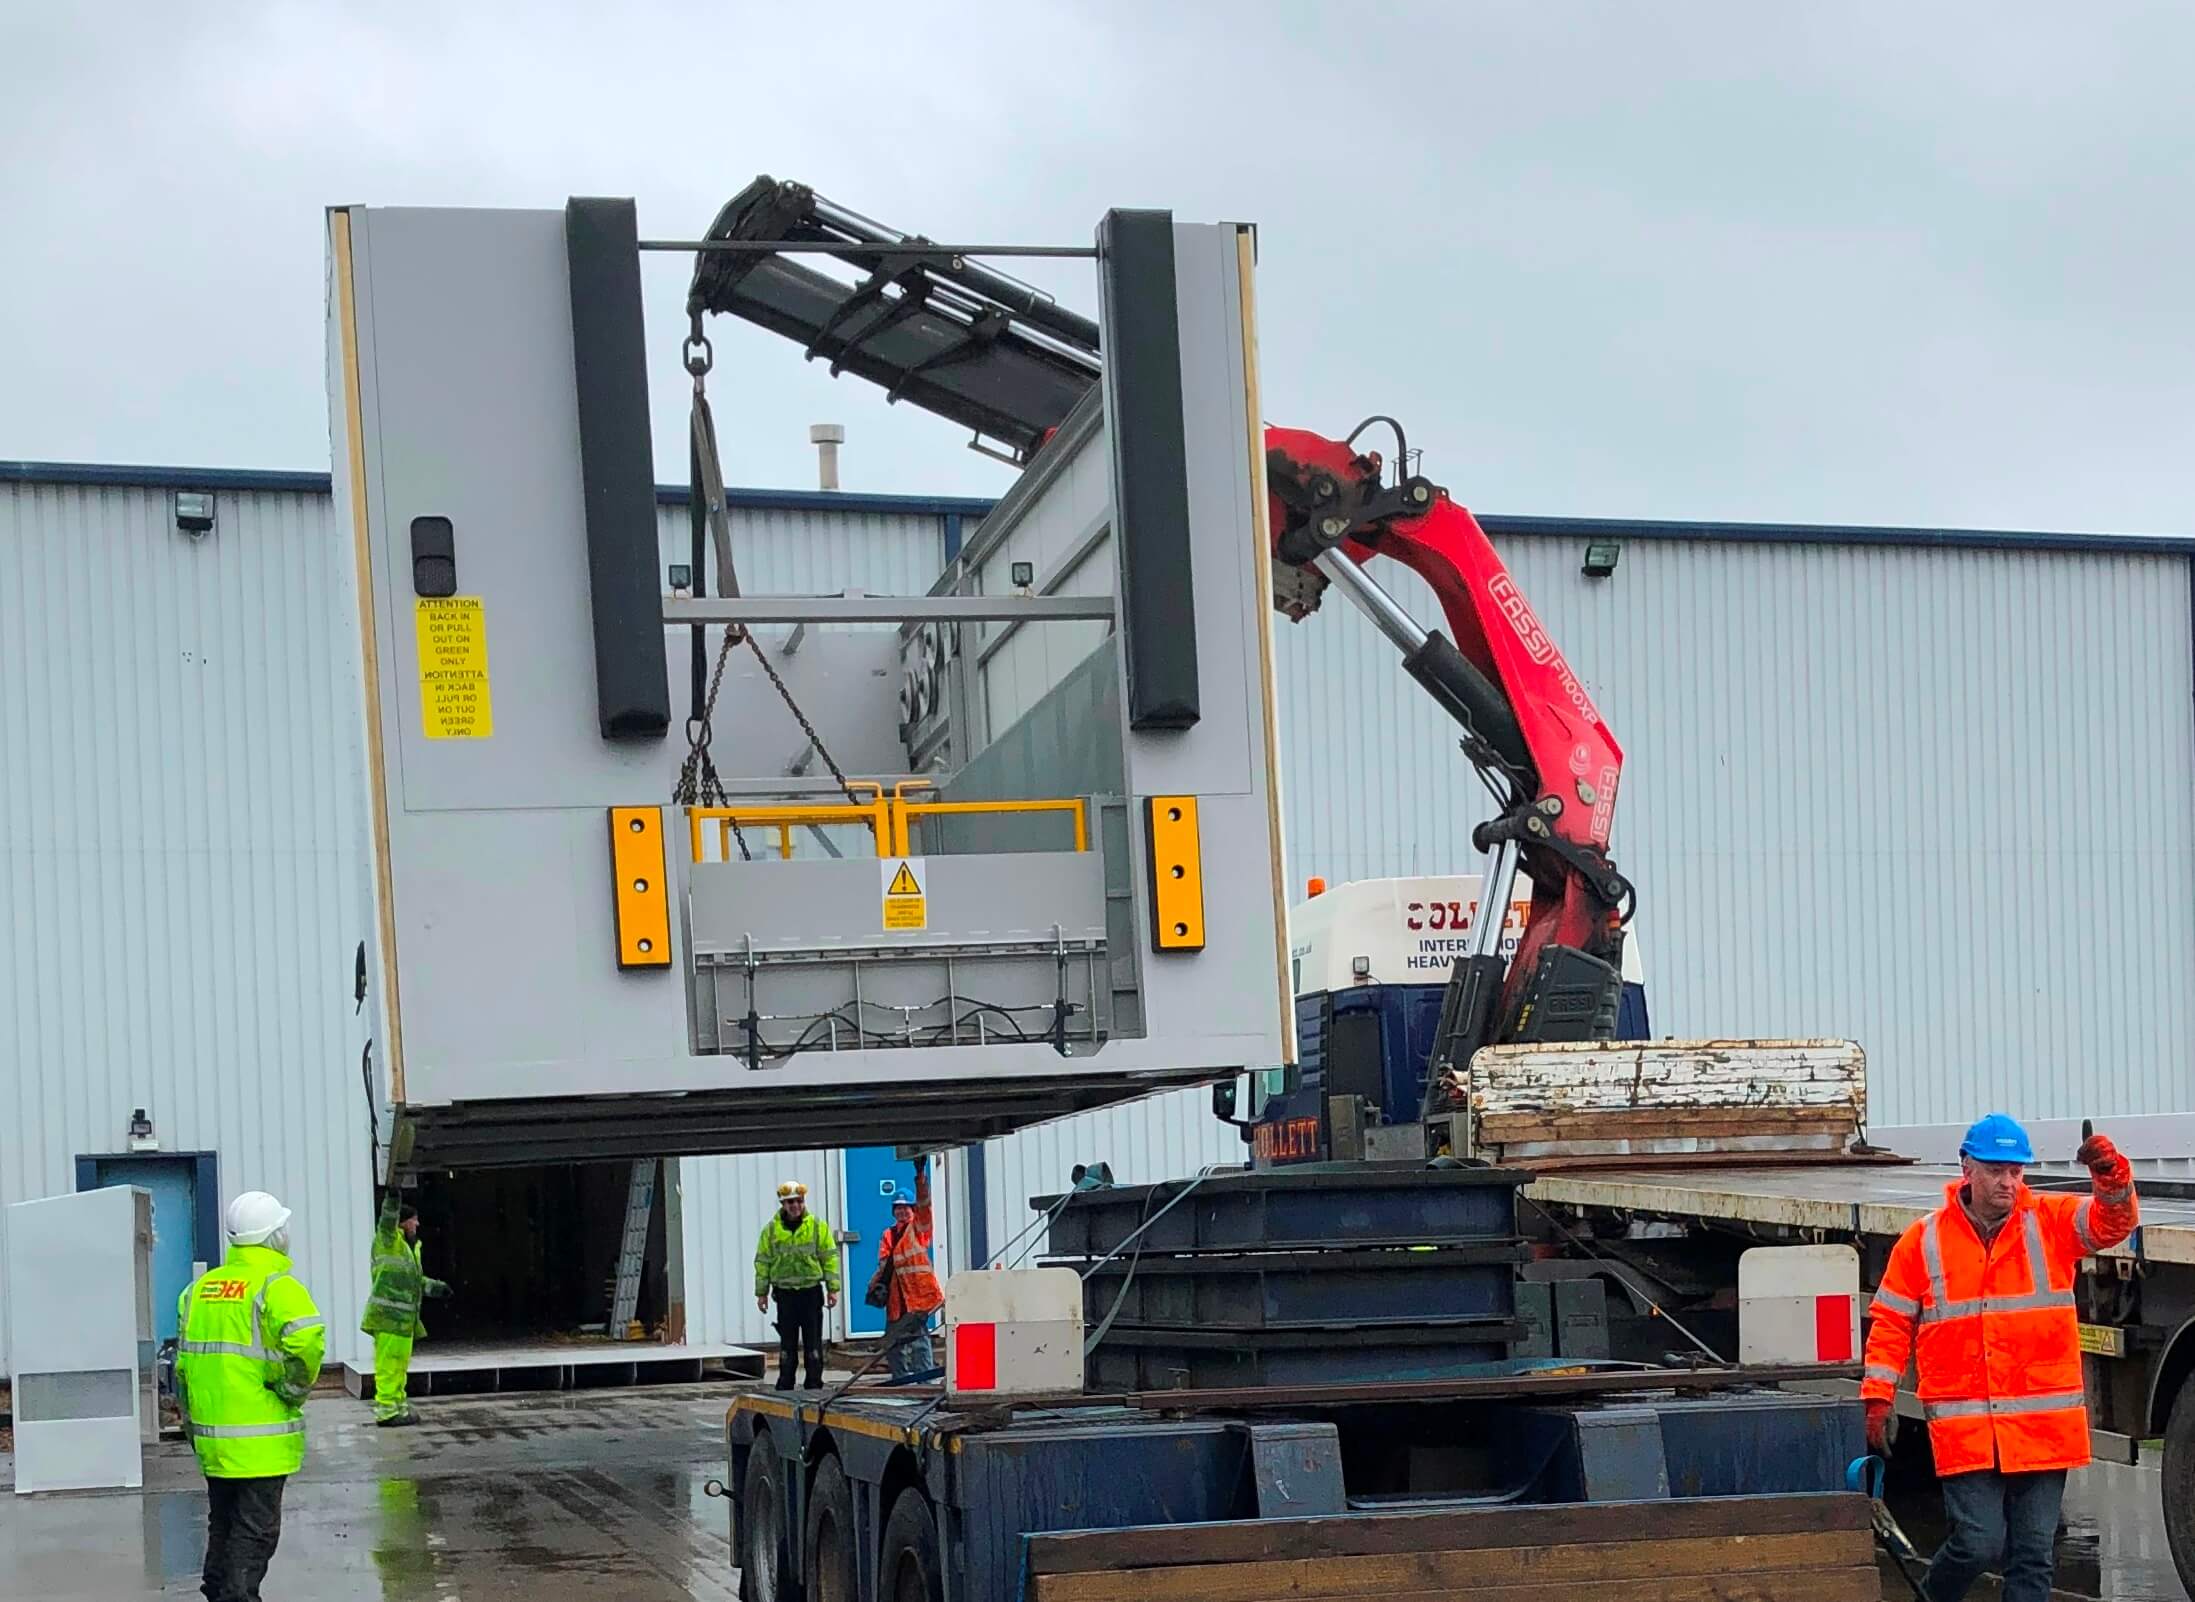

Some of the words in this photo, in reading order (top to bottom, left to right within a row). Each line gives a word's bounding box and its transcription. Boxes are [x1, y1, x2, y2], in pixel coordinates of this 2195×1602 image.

[419, 599, 479, 609] ATTENTION
[430, 613, 457, 621] BACK
[460, 613, 470, 621] IN
[1493, 580, 1550, 658] FASSI
[430, 624, 444, 632] OR
[447, 624, 472, 632] PULL
[433, 635, 453, 643] OUT
[455, 635, 470, 643] ON
[435, 646, 470, 654] GREEN
[440, 657, 466, 665] ONLY
[1593, 771, 1617, 837] FASSI
